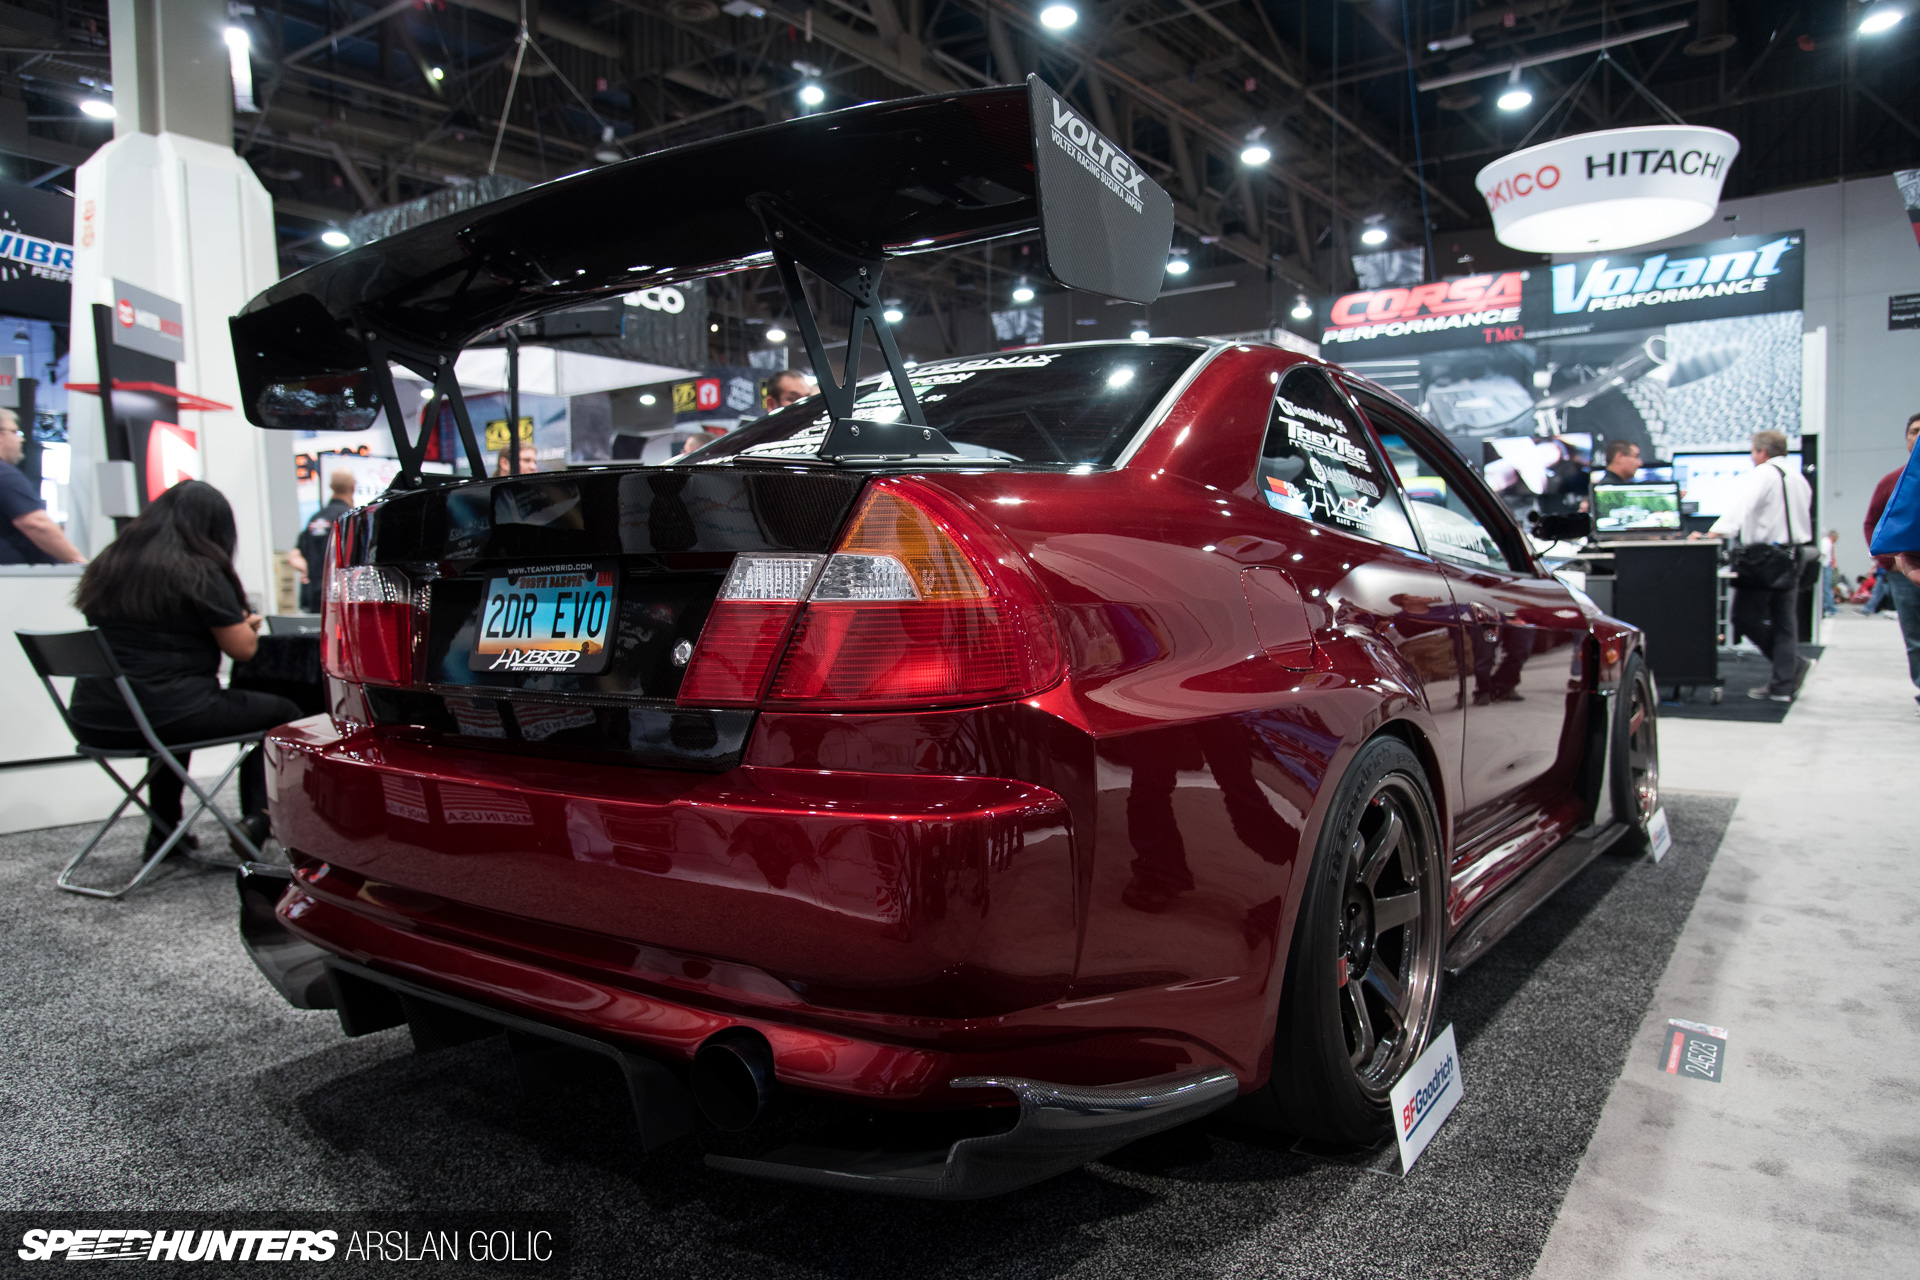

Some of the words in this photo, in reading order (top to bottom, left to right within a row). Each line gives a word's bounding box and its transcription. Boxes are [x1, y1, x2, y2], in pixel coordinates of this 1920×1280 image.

[1052, 97, 1145, 197] VOLTEX
[1586, 150, 1725, 180] HITACHI
[1051, 129, 1076, 159] VOLTEX
[1077, 151, 1101, 179] RACING
[1101, 171, 1124, 199] SUZUKA
[1124, 193, 1143, 214] JAPAN
[0, 230, 74, 273] VIBR
[1551, 236, 1794, 314] Volant
[1588, 276, 1769, 313] PERFORMANCE
[1330, 271, 1522, 326] CORSA
[1321, 306, 1522, 345] PERFORMANCE
[1305, 478, 1325, 490] TEAM
[507, 563, 593, 575] WWW.TEAMHYBRID.COM
[519, 576, 547, 589] NORTH
[549, 575, 583, 588] DAKOTA
[485, 593, 538, 639] 2DR
[551, 590, 606, 639] EVO
[488, 649, 581, 670] HYBRID
[1685, 1040, 1718, 1078] 24523
[1403, 1053, 1454, 1132] BFGoodrich
